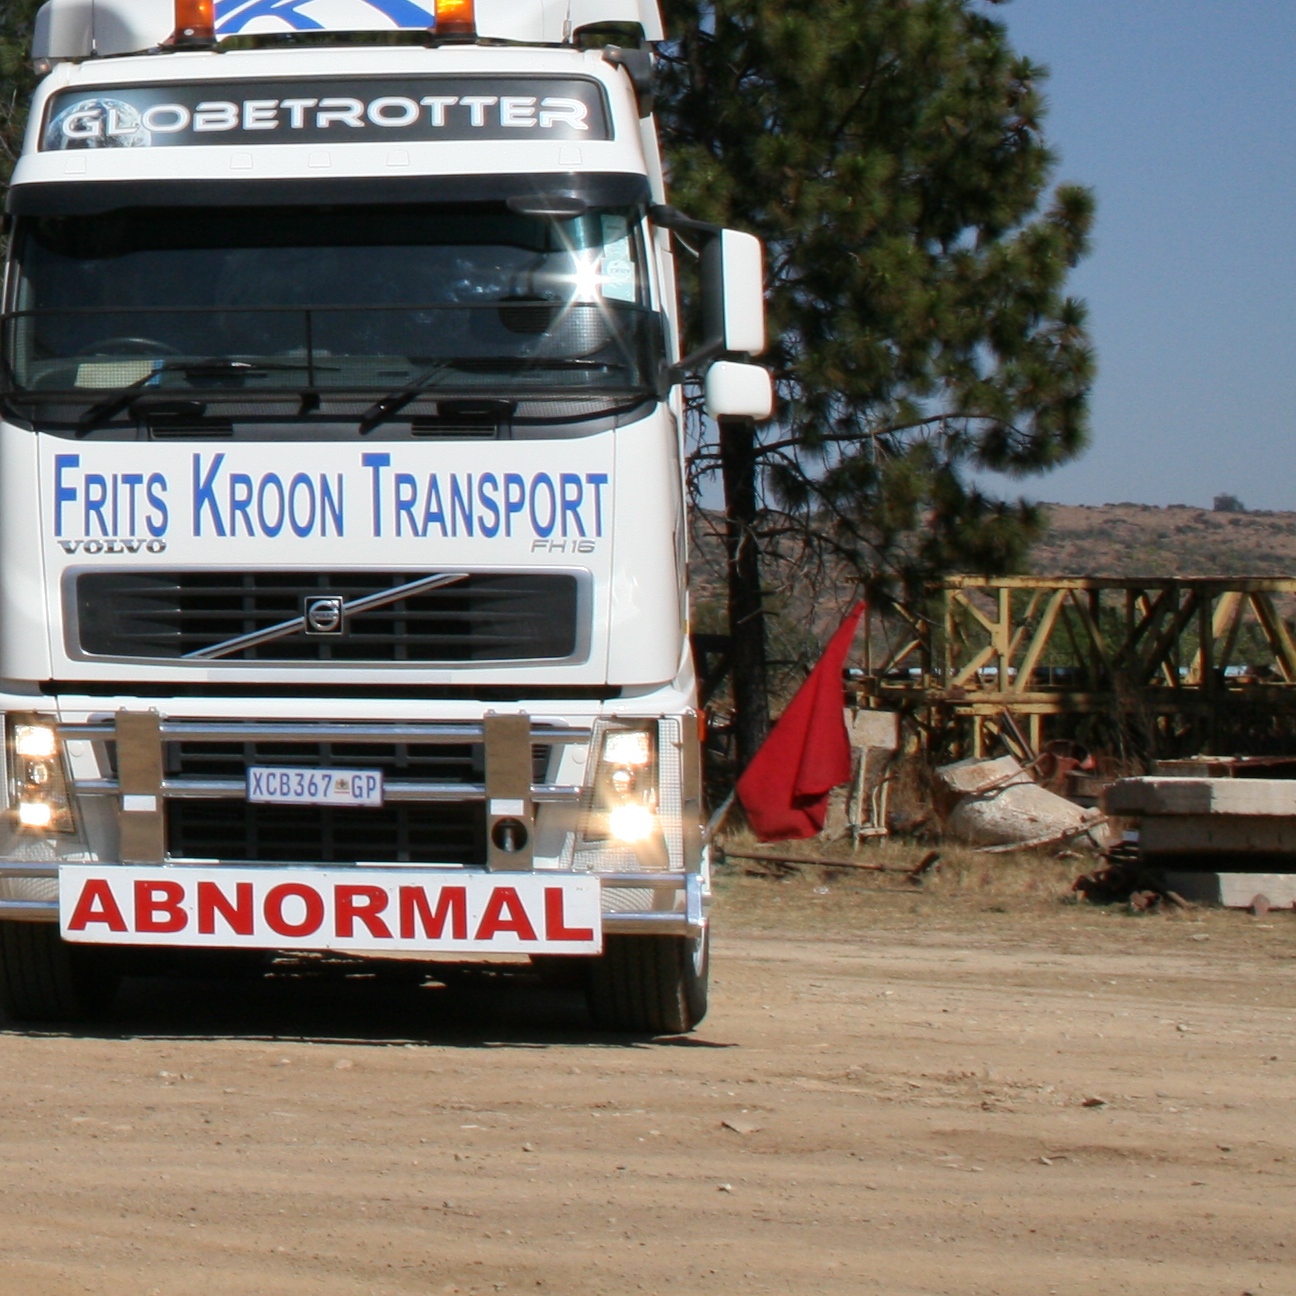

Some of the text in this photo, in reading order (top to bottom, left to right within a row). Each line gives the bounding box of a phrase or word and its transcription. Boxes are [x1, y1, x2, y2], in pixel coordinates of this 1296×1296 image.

[62, 96, 590, 140] GLOBETROTTER
[58, 538, 167, 555] VOLVO
[530, 538, 596, 554] FH16
[252, 771, 377, 799] XCB367 GP
[67, 878, 594, 941] ABNORMAL
